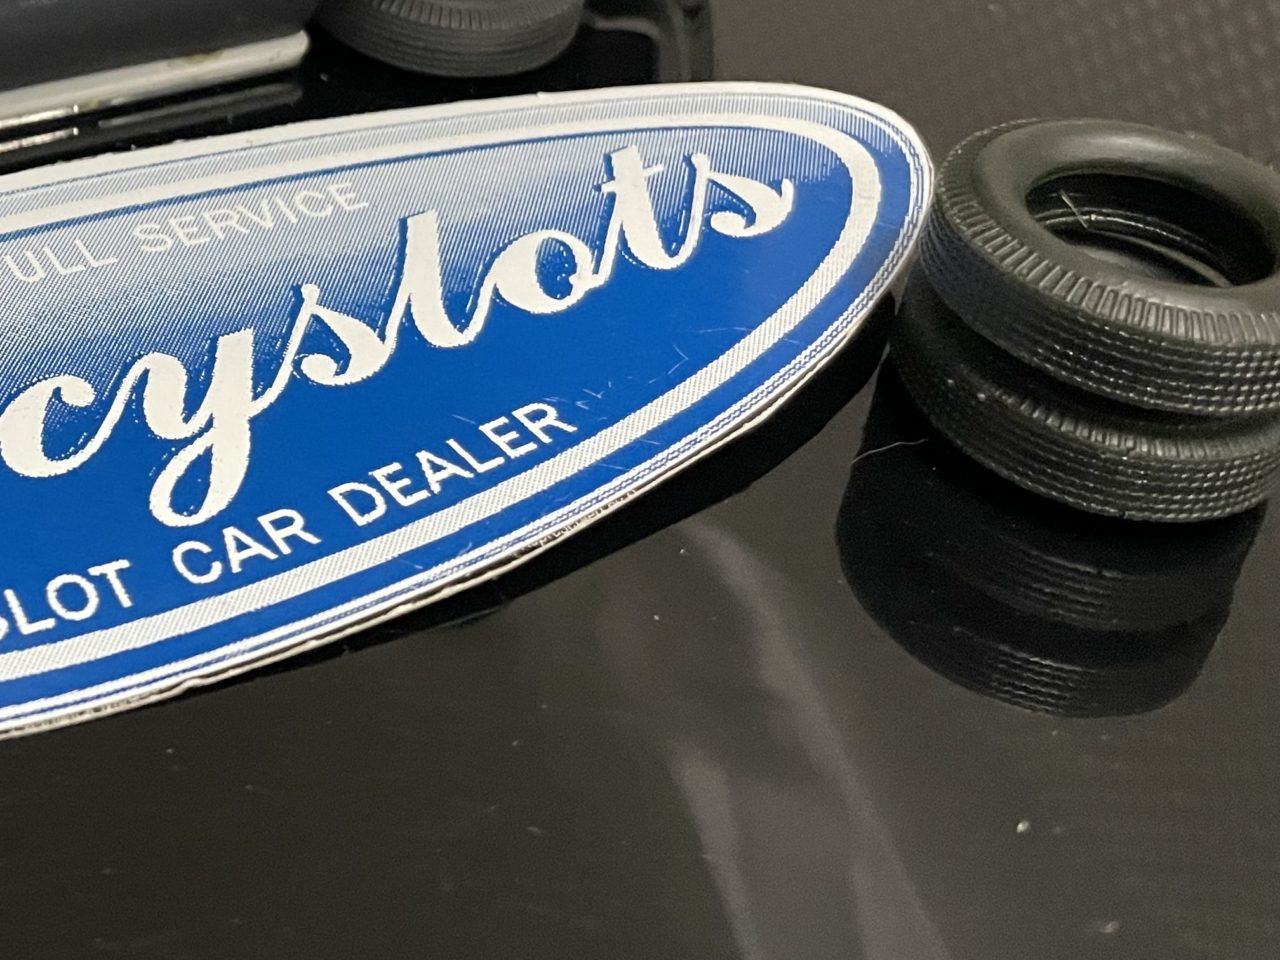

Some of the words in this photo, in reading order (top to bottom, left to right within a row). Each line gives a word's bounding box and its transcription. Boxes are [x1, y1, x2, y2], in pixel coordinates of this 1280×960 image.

[131, 181, 370, 257] SERVICE
[172, 508, 322, 585] CAR
[326, 401, 578, 528] DEALER
